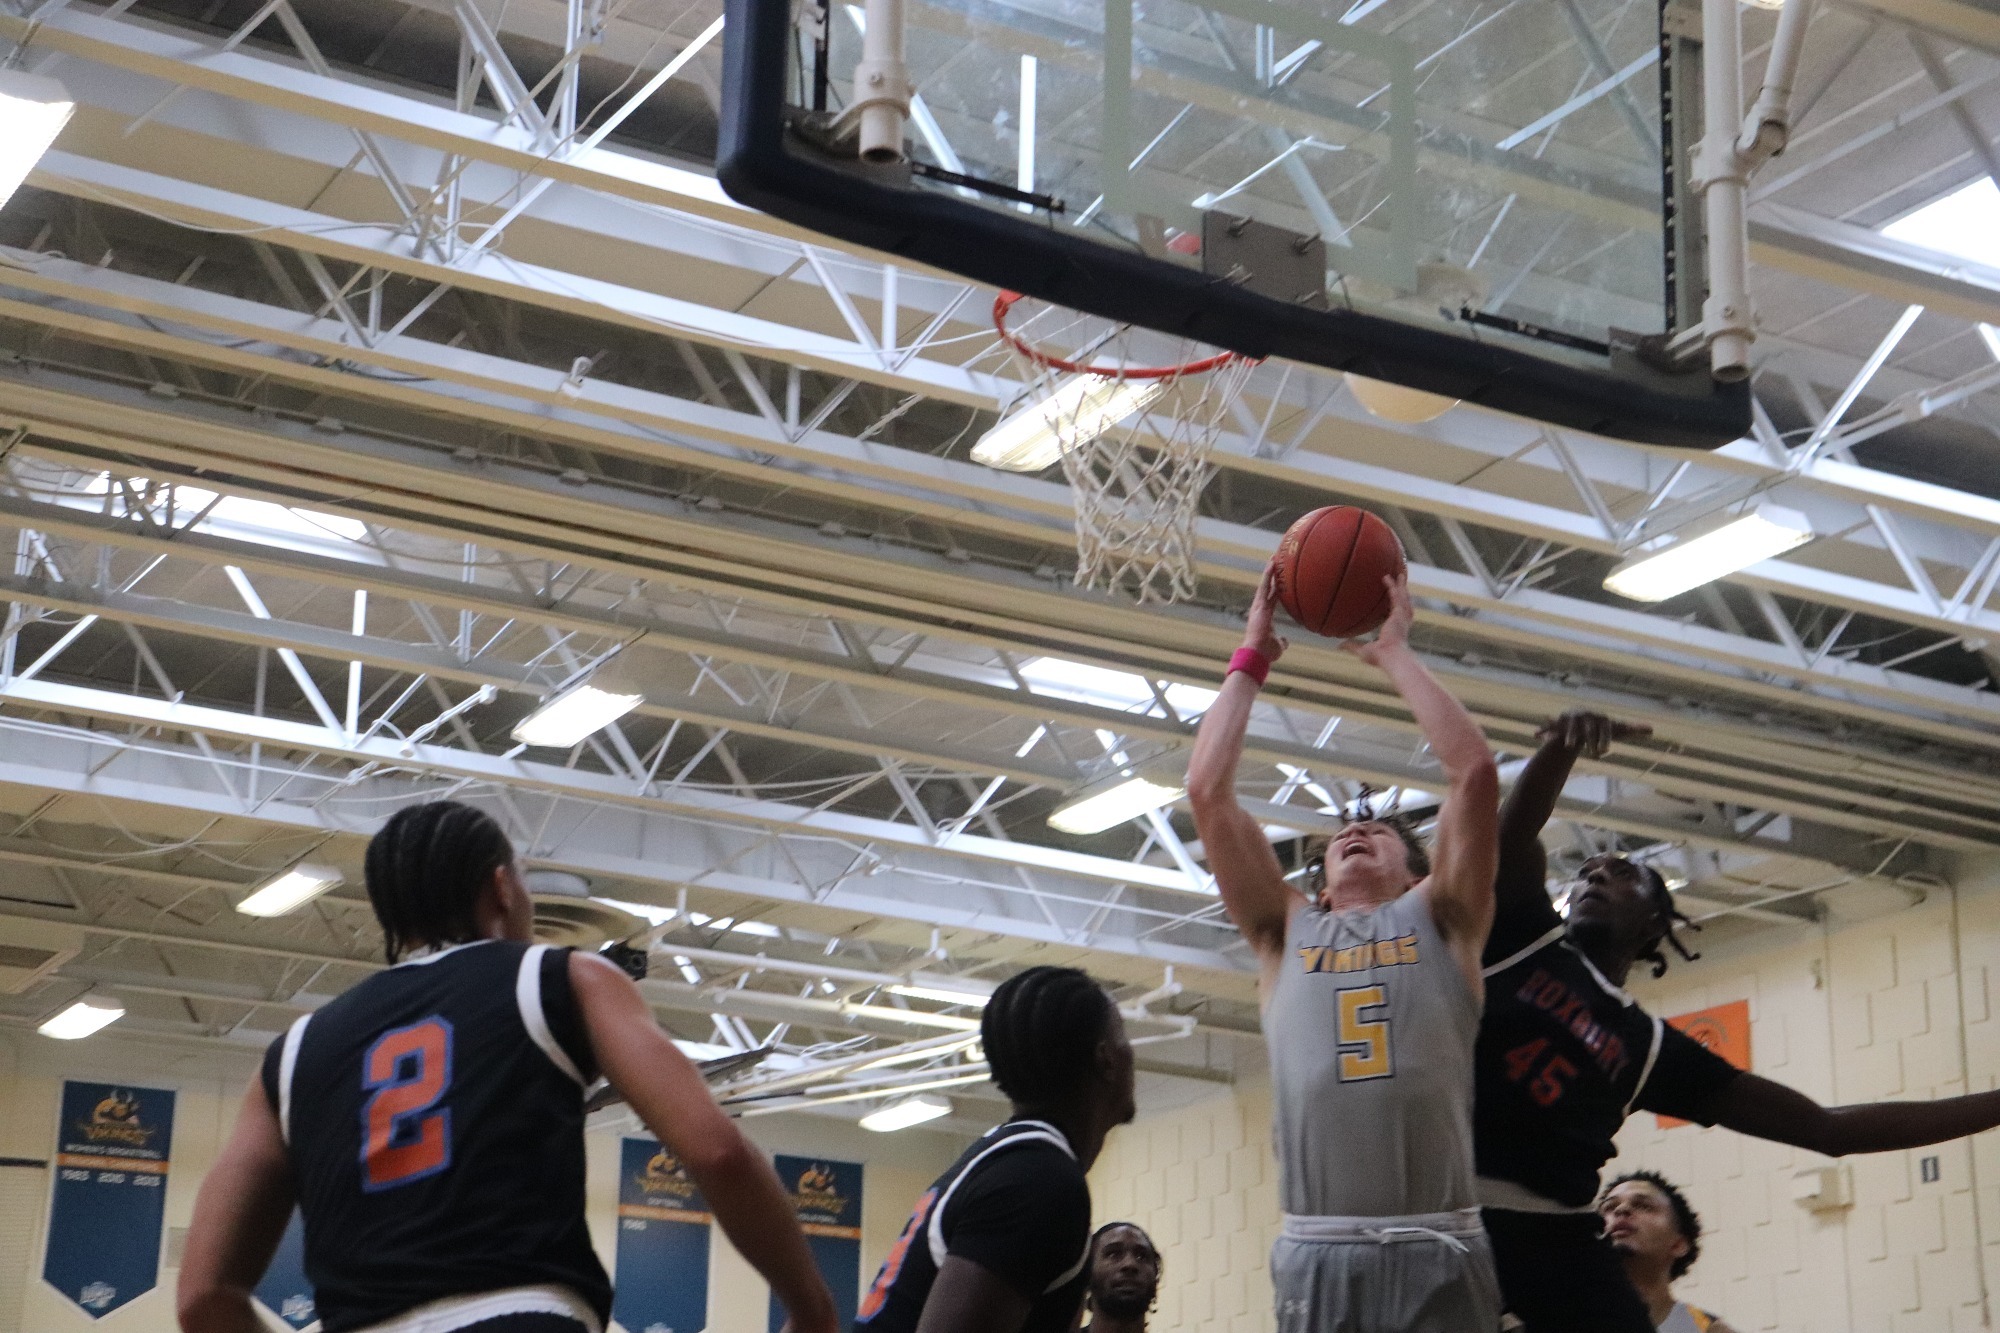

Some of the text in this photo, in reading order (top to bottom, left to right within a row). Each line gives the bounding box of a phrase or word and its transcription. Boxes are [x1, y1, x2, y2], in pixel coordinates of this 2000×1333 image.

[1334, 983, 1395, 1084] 5
[1505, 1038, 1578, 1105] 45
[359, 1014, 454, 1194] 2
